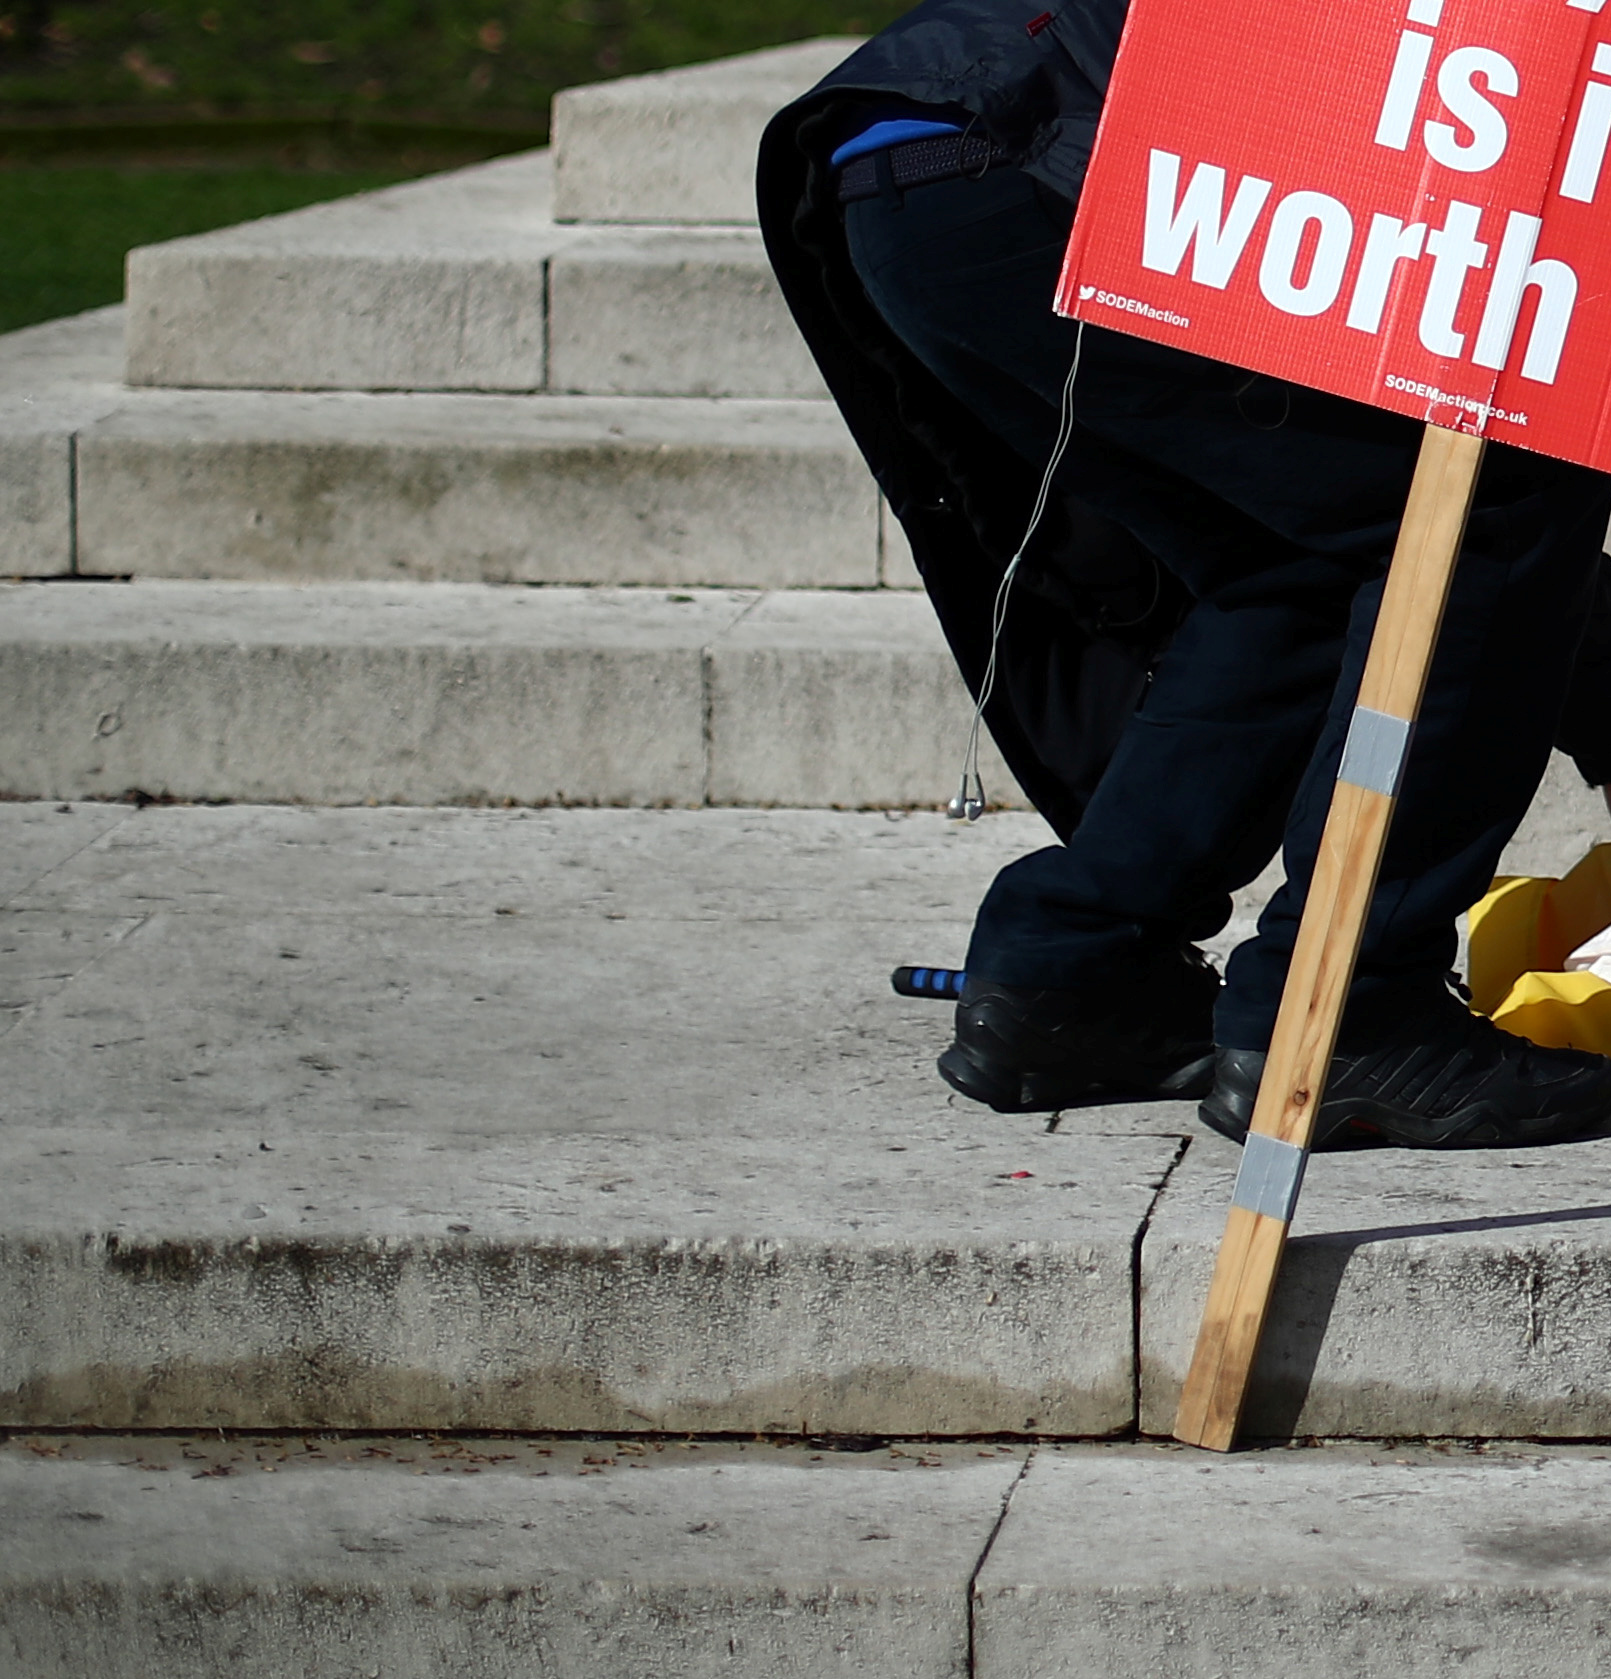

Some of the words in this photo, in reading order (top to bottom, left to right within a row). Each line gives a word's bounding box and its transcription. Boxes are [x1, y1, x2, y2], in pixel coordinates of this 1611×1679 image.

[1141, 149, 1580, 385] worth
[1095, 290, 1190, 328] SODEMaction
[1384, 374, 1528, 425] SODEMactionco.uk
